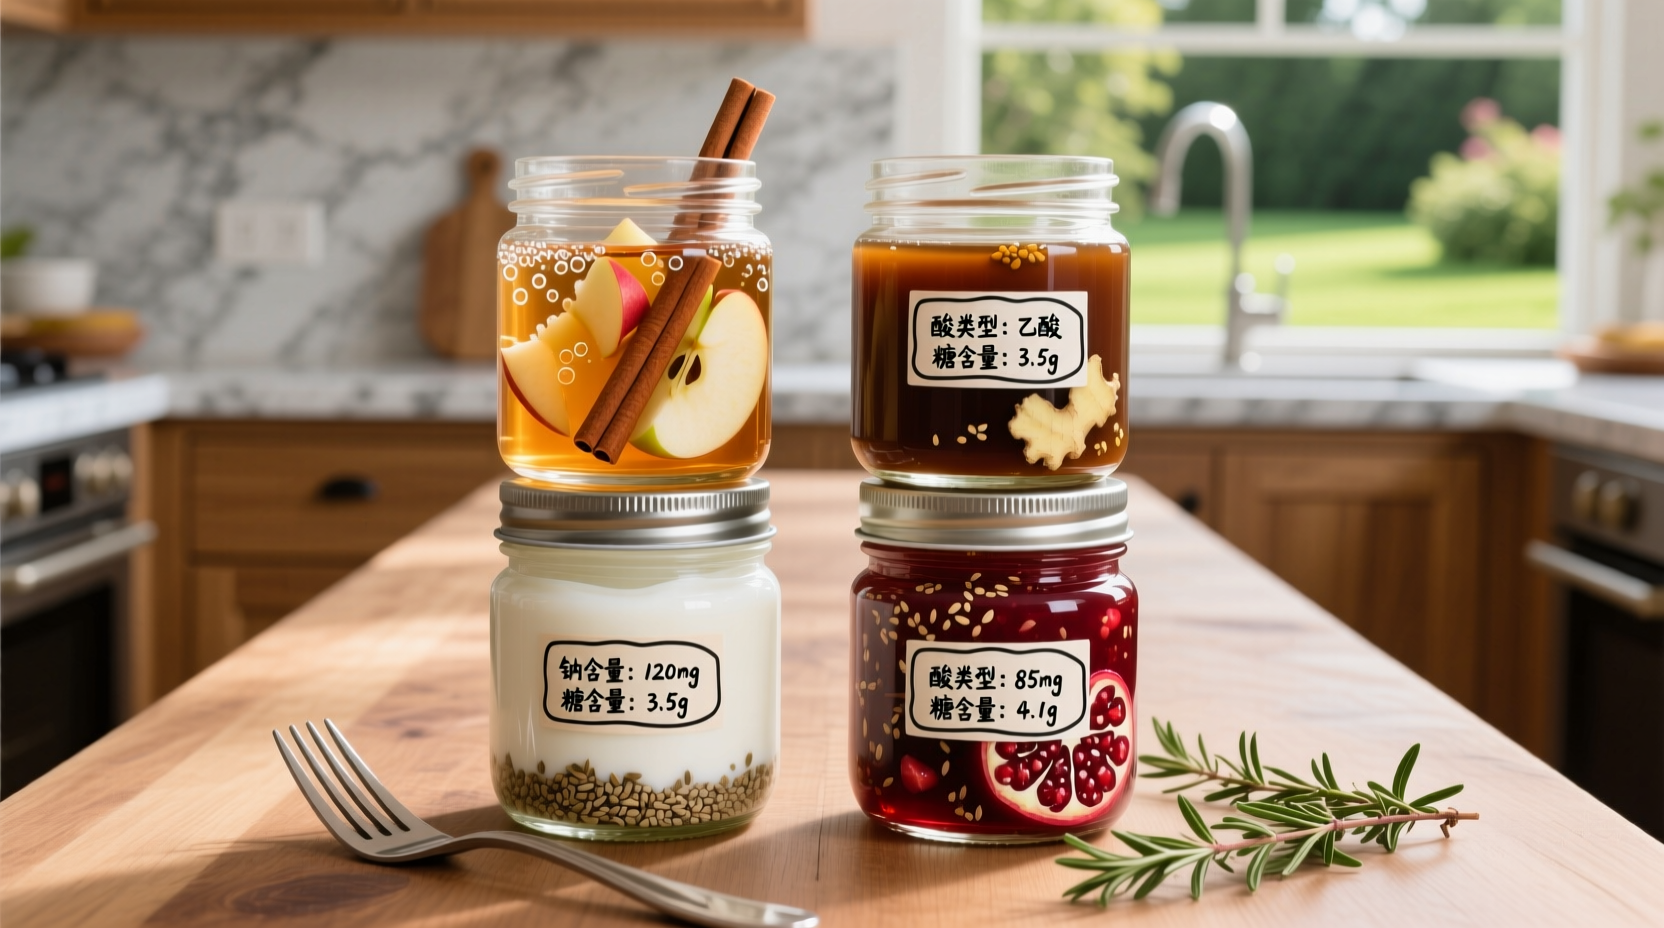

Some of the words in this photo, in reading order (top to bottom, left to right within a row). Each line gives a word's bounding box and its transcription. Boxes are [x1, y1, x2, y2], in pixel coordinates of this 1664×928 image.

[1018, 313, 1063, 339] 乙酸
[1018, 347, 1059, 375] 3.5g
[645, 662, 700, 689] 120mg
[1015, 669, 1063, 697] 85mg
[647, 692, 689, 719] 3.5g
[1017, 700, 1058, 727] 4.1g
